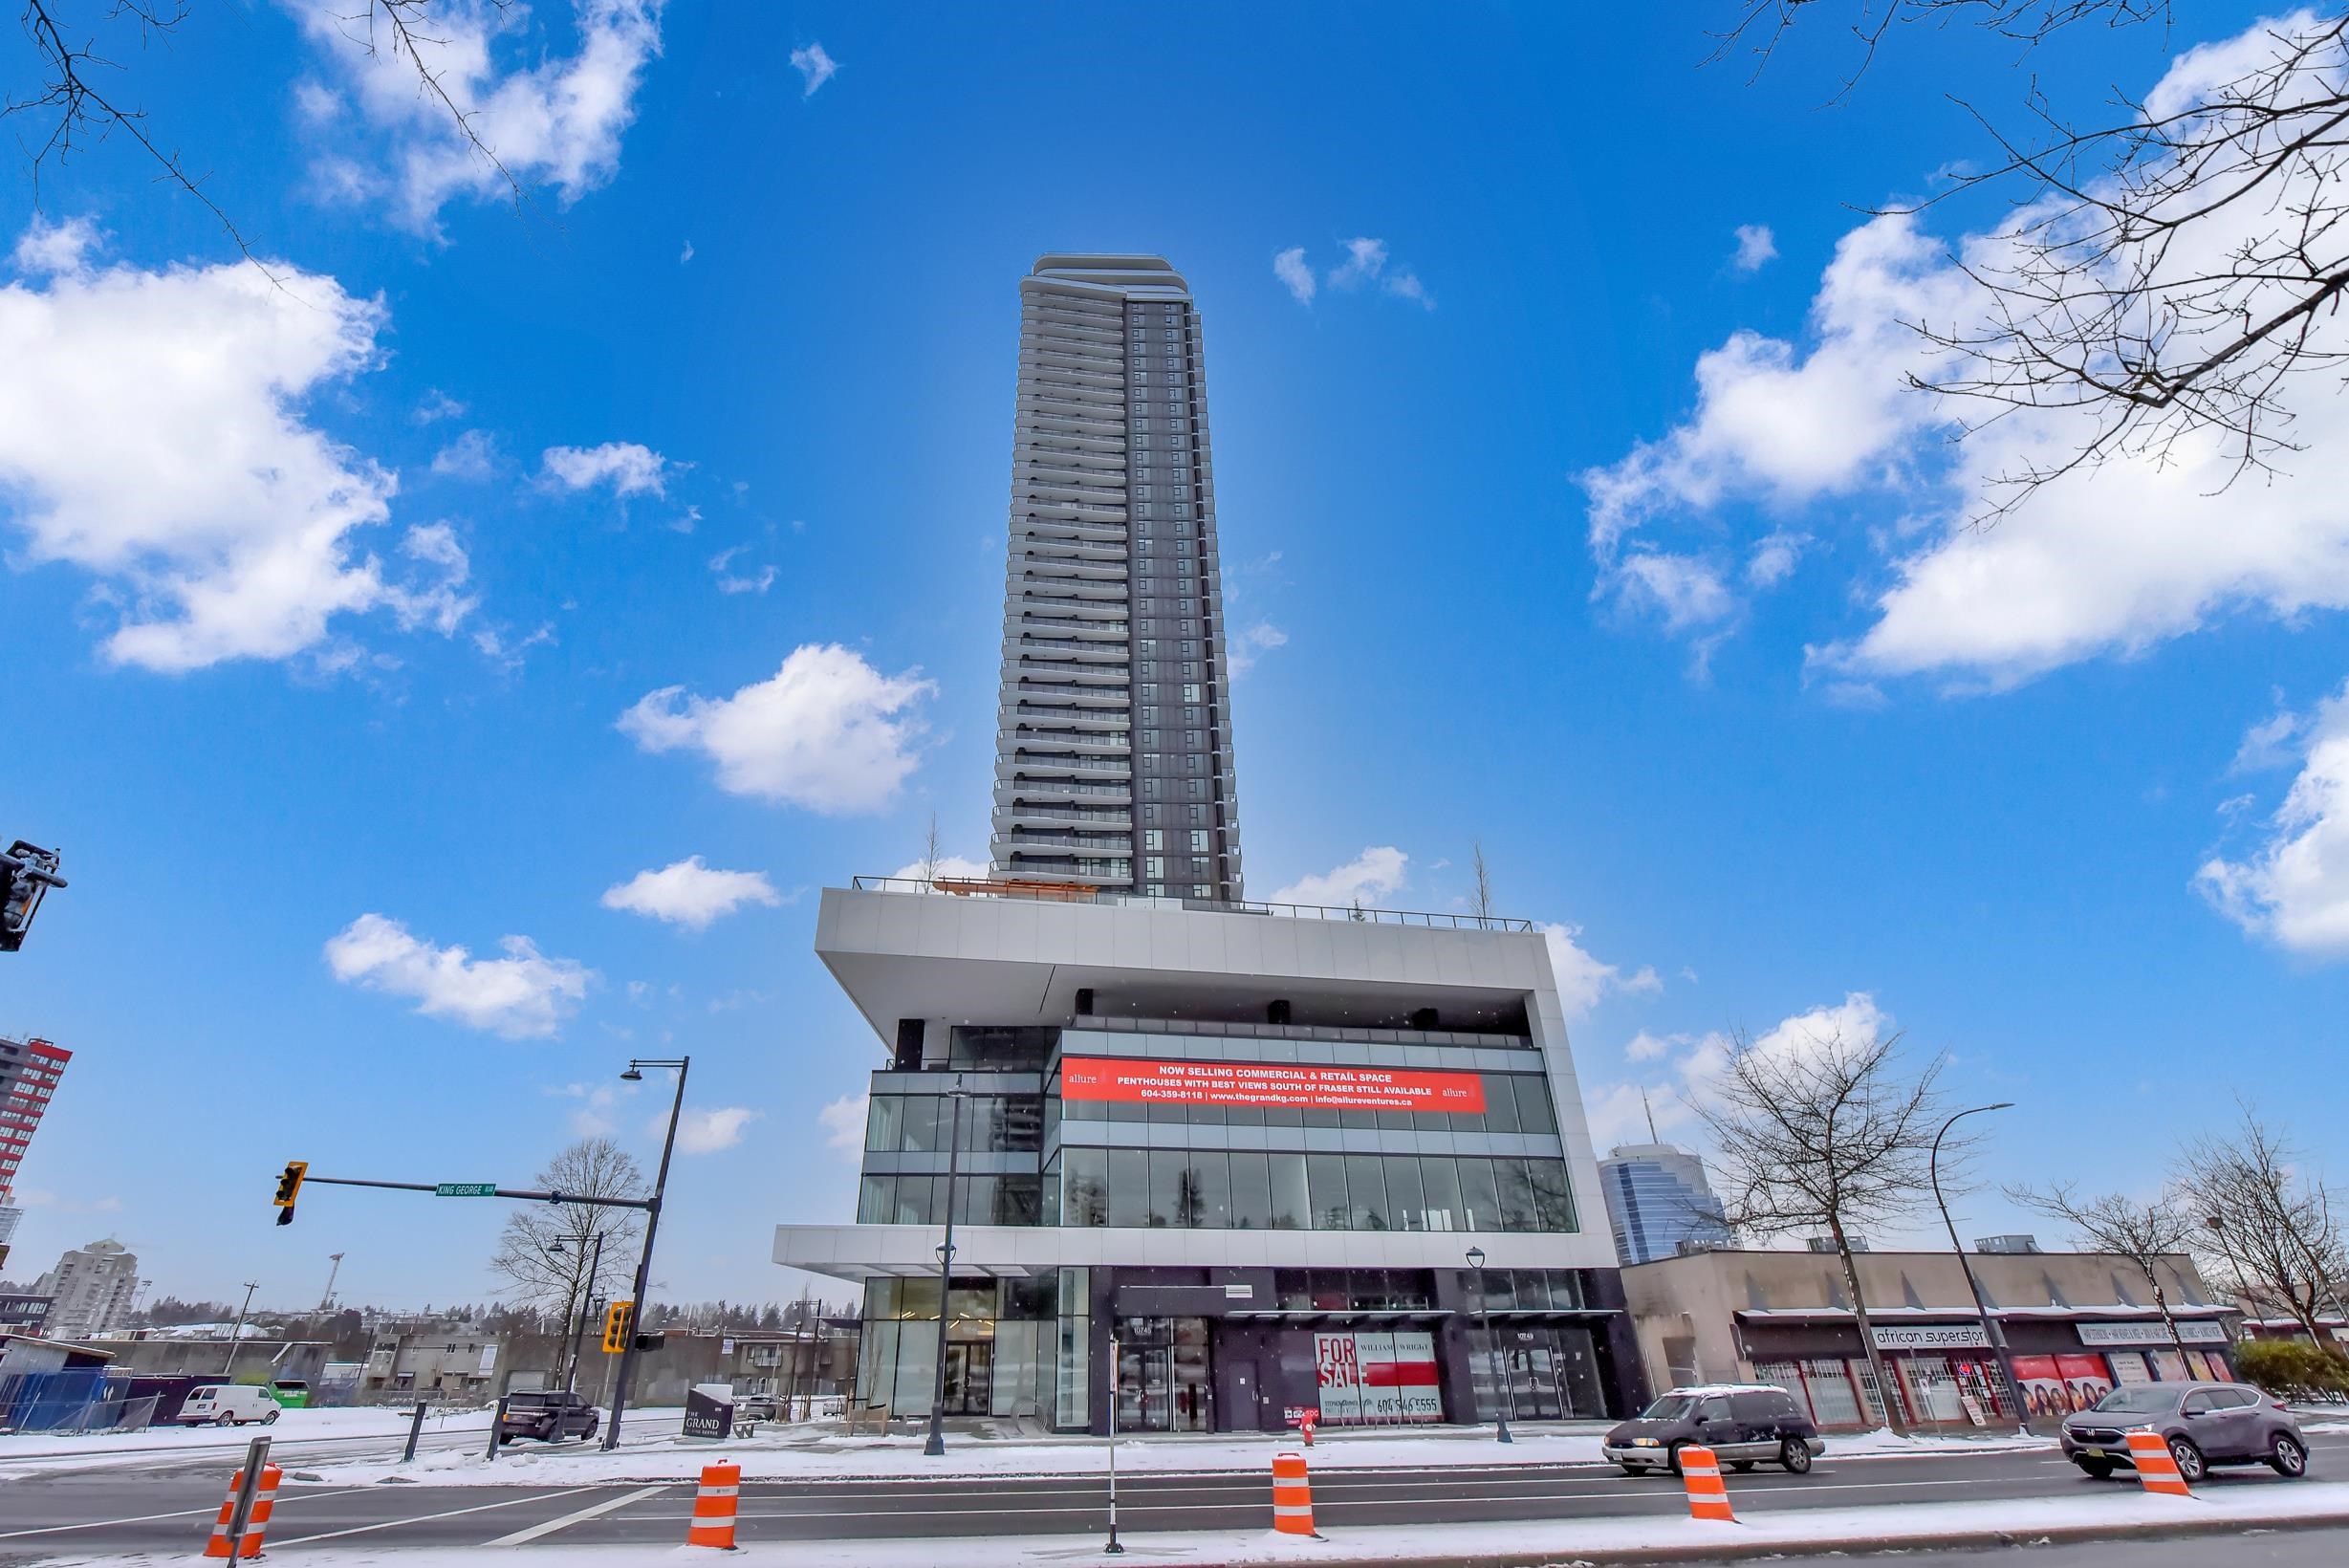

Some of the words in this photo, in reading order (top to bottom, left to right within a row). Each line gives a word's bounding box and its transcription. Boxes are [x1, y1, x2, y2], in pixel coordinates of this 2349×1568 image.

[1069, 1073, 1097, 1084] allure
[1159, 1066, 1185, 1076] NOW
[1187, 1067, 1233, 1078] SELLING
[1236, 1069, 1307, 1080] COMMERCIAL
[1309, 1071, 1317, 1080] &
[1320, 1071, 1357, 1082] RETAIL
[1359, 1073, 1392, 1083] SPACE
[1117, 1077, 1182, 1087] PENTHOUSES
[1184, 1078, 1209, 1088] WITH
[1211, 1079, 1235, 1089] BEST
[1238, 1081, 1268, 1090] VIEWS
[1270, 1082, 1302, 1092] SOUTH
[1304, 1083, 1316, 1092] OF
[1318, 1084, 1355, 1094] FRASER
[1356, 1085, 1381, 1095] STILL
[1383, 1086, 1432, 1097] AVAILABLE
[1442, 1088, 1468, 1098] allure
[1141, 1089, 1203, 1100] 604-359-8118
[1210, 1092, 1309, 1103] www.thegrandkg.com
[438, 1186, 455, 1195] KING
[456, 1186, 482, 1195] GEORGE
[1878, 1328, 1923, 1343] african
[1925, 1326, 1984, 1346] superstor
[1318, 1338, 1356, 1363] FOR
[1360, 1343, 1394, 1352] WILLIAM
[1318, 1362, 1370, 1388] SALE
[1377, 1399, 1393, 1413] 604
[1416, 1398, 1437, 1412] 5555
[685, 1417, 720, 1429] GRAND
